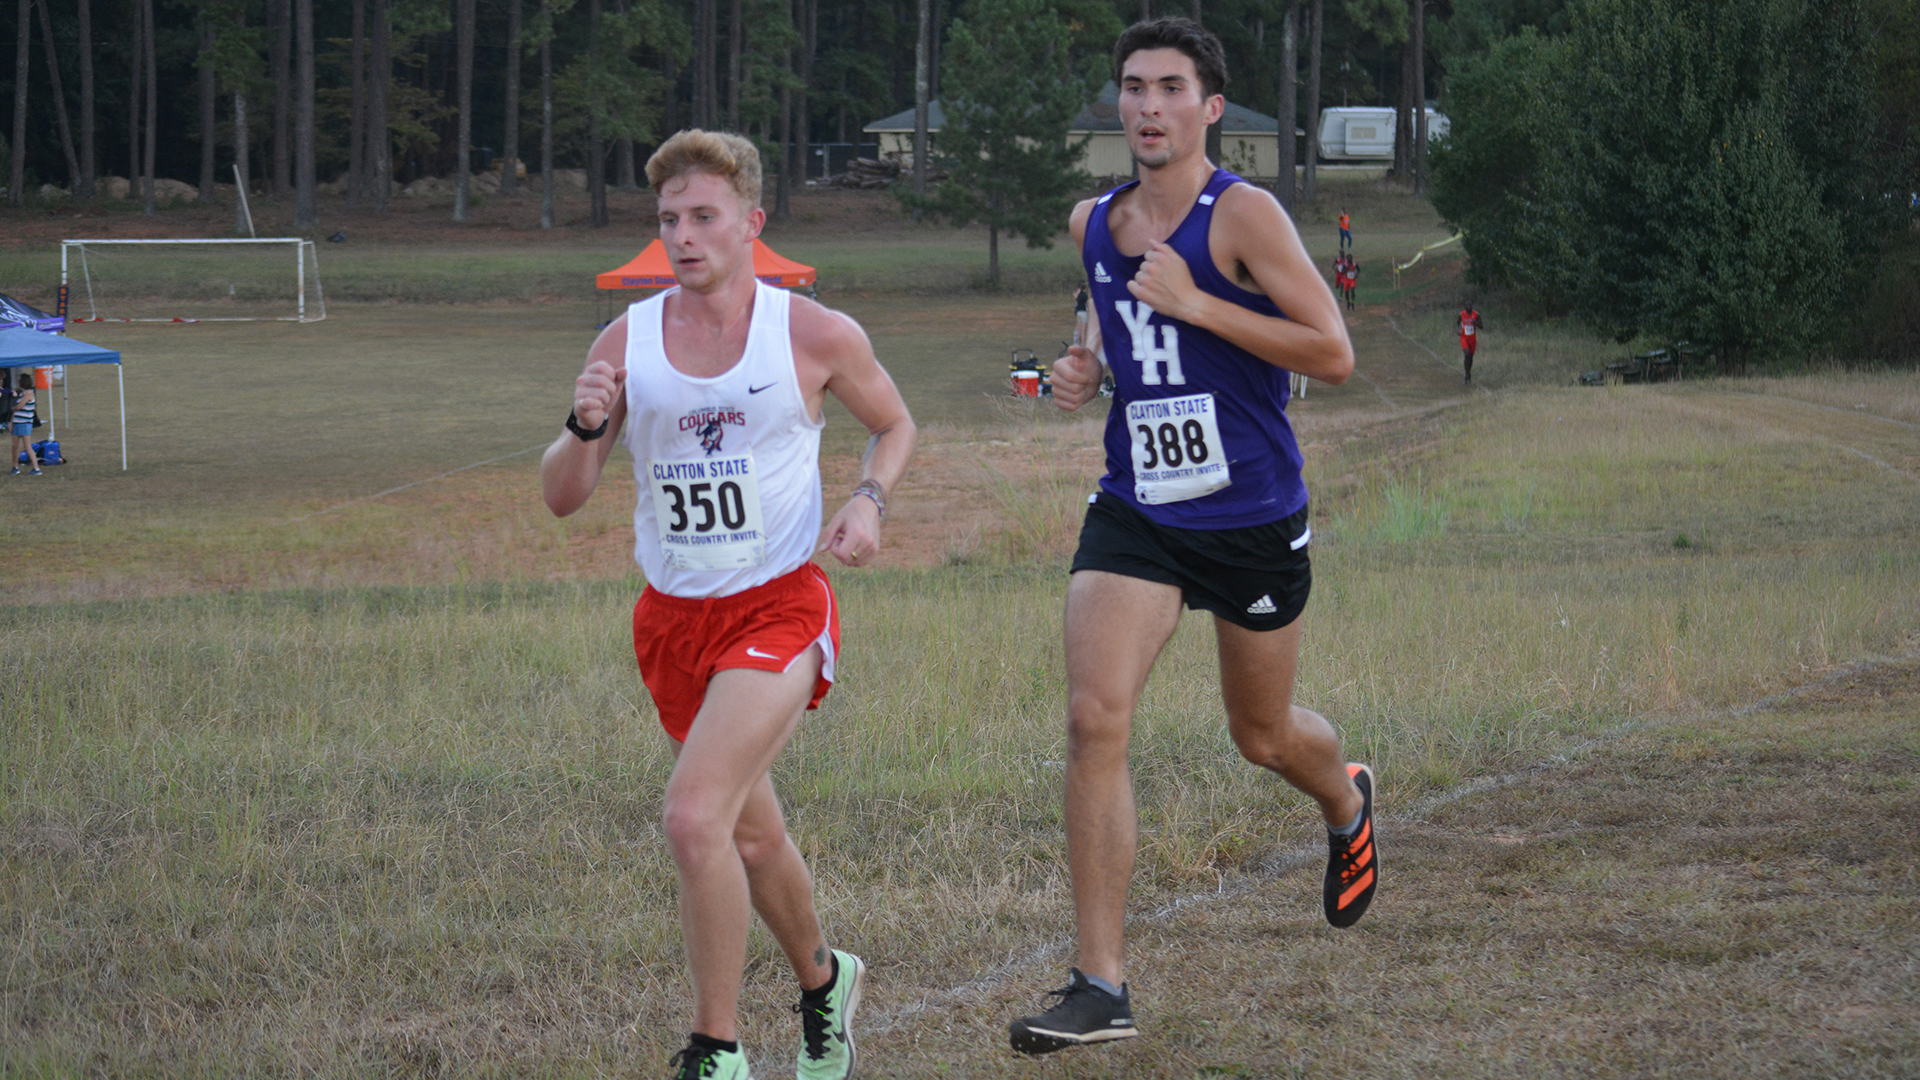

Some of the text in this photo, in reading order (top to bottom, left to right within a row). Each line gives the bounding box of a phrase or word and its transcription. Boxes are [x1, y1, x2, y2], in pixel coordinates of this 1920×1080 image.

[622, 277, 653, 286] Clayton
[654, 276, 676, 285] State
[59, 288, 67, 317] STAR
[1130, 398, 1208, 420] CLAYTON STATE
[679, 411, 745, 431] COUGARS
[1136, 418, 1209, 470] 388
[653, 458, 749, 480] CLAYTON STATE
[1140, 463, 1221, 480] CROSS COUNTRY INVITE
[662, 480, 746, 533] 350
[666, 530, 758, 545] CROSS COUNTRY INVITE
